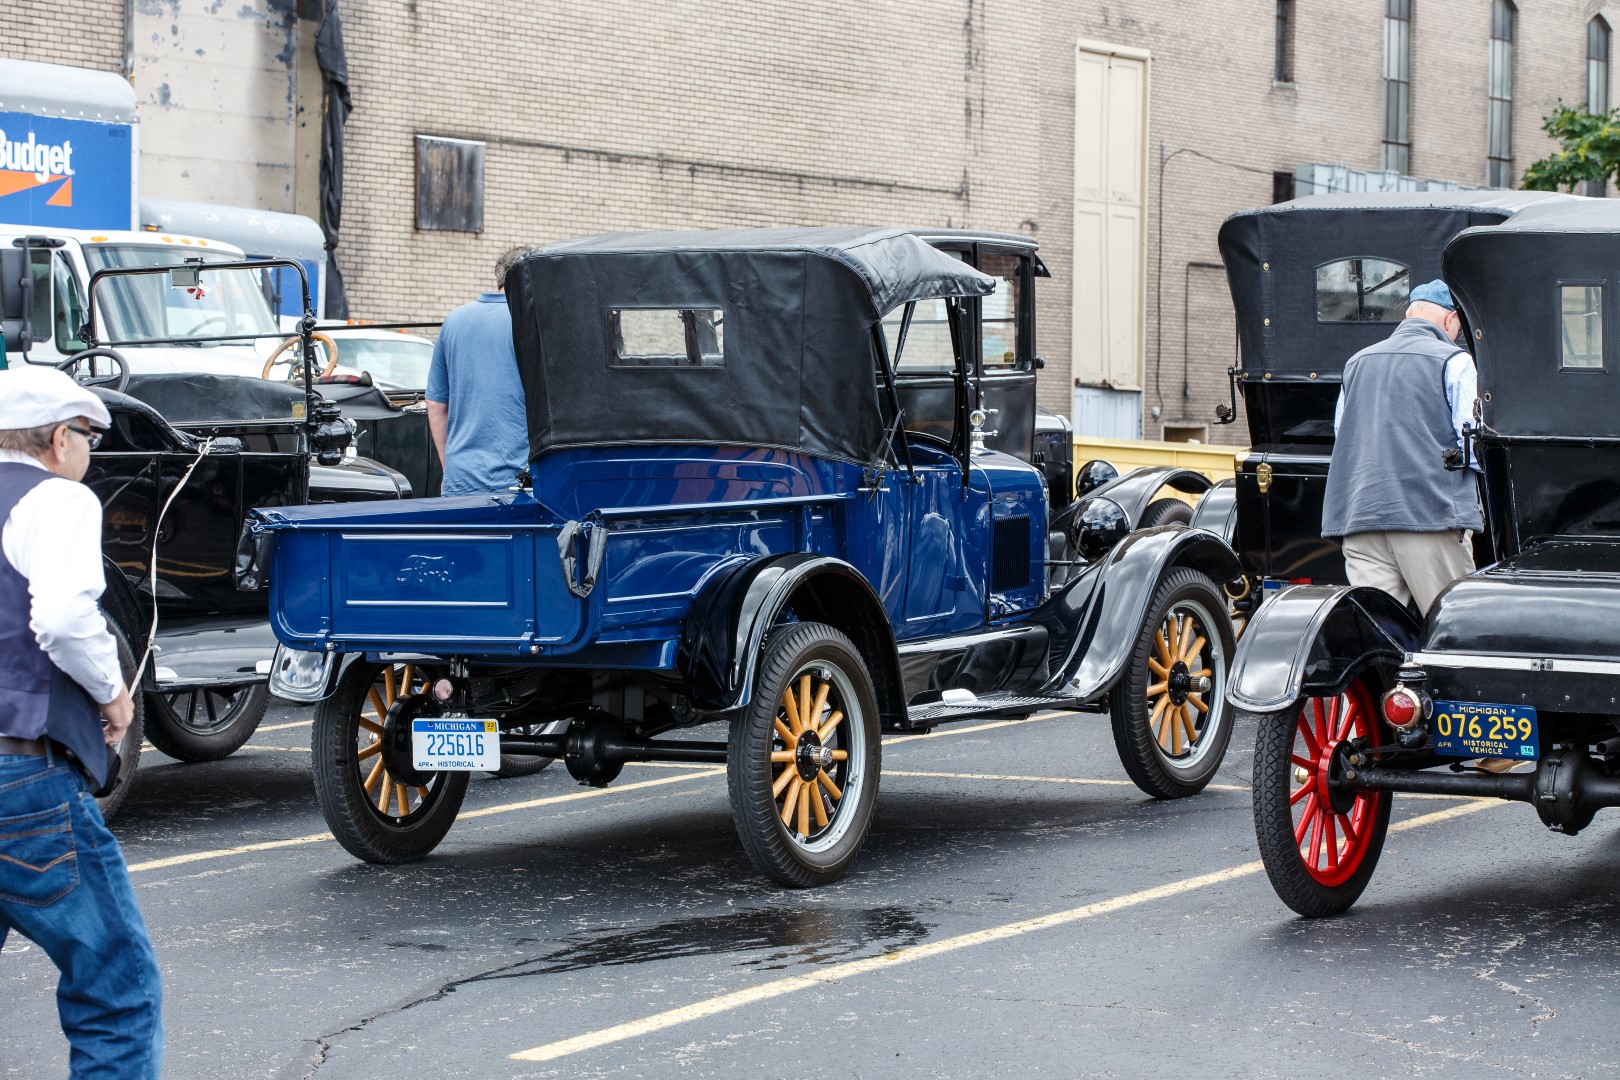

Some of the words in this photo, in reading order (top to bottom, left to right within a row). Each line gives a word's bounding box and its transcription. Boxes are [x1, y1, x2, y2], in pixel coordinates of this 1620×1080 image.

[396, 553, 455, 585] Ford
[1459, 706, 1507, 715] MICHIGAN
[434, 722, 477, 731] MICHIGAN
[1437, 713, 1483, 739] 076
[1488, 716, 1531, 741] 259
[427, 734, 484, 756] 225616
[1463, 739, 1509, 749] HISTORICAL
[1469, 747, 1503, 755] VEHICLE
